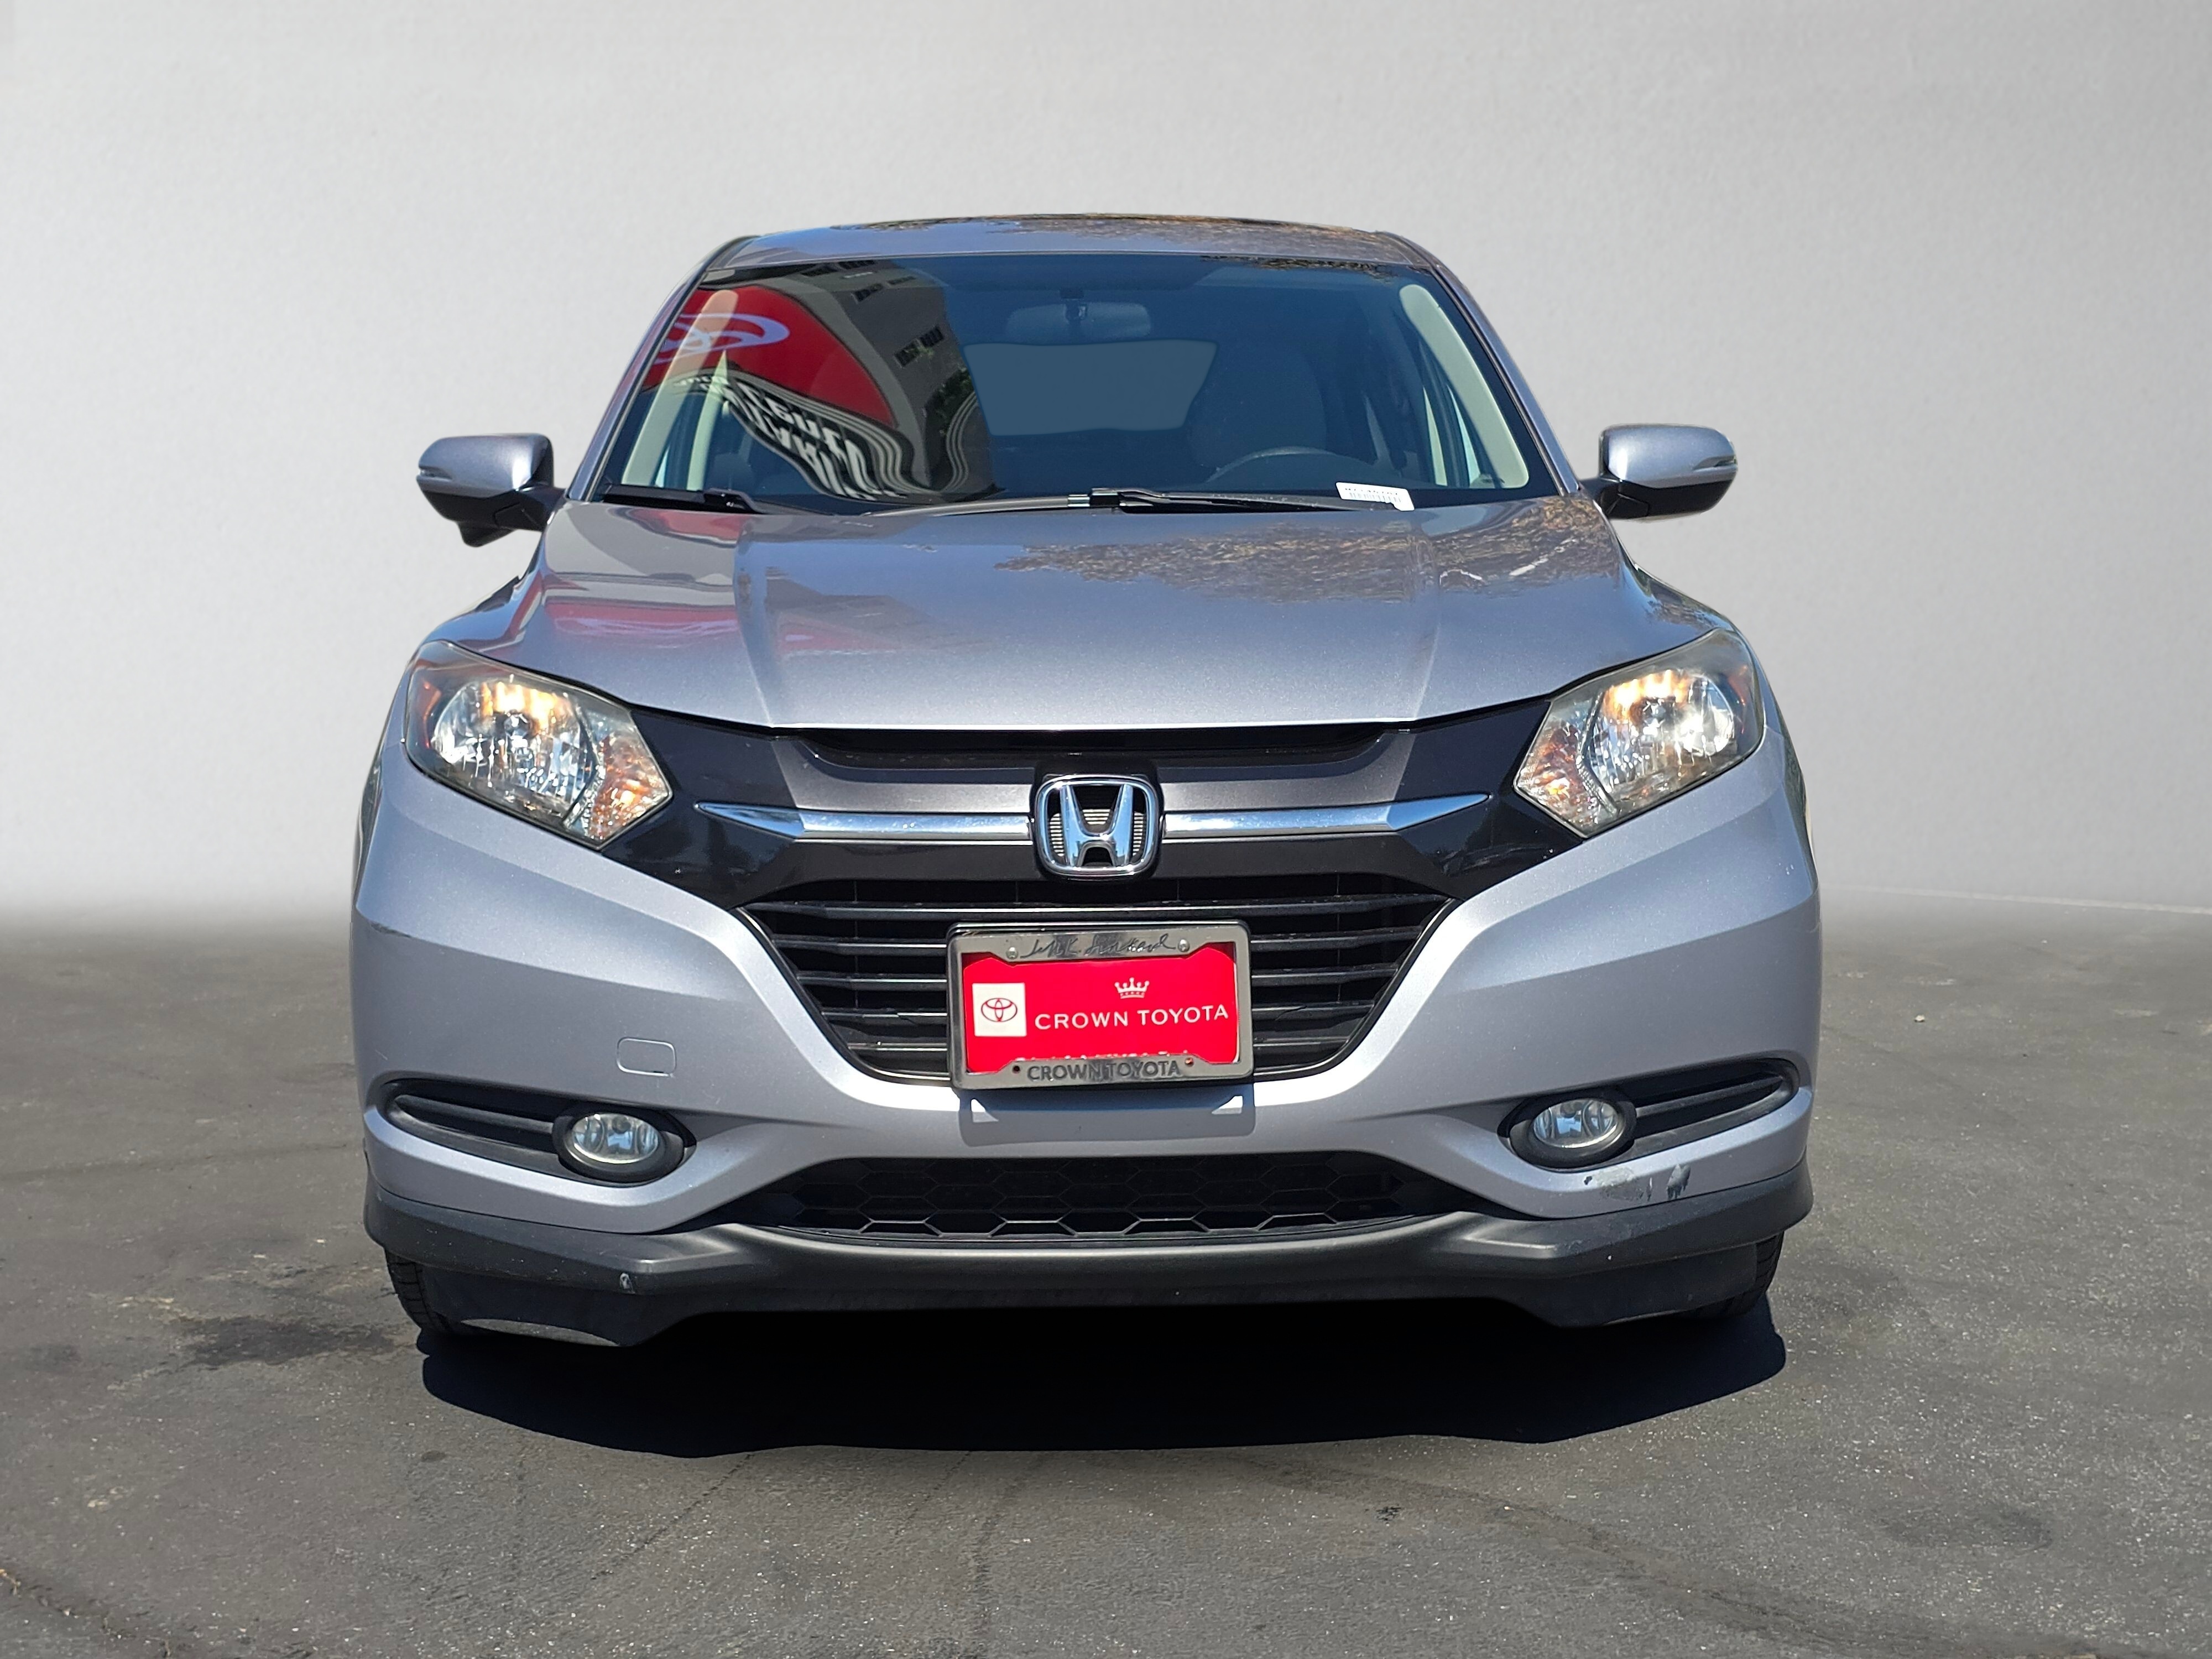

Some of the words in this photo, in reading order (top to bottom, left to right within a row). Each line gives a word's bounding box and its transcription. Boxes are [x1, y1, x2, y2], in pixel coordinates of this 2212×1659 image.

[1034, 1010, 1129, 1030] CROWN
[1136, 1004, 1229, 1026] TOYOTA
[1027, 1063, 1103, 1082] CROWN
[1106, 1060, 1182, 1077] TOYOTA
